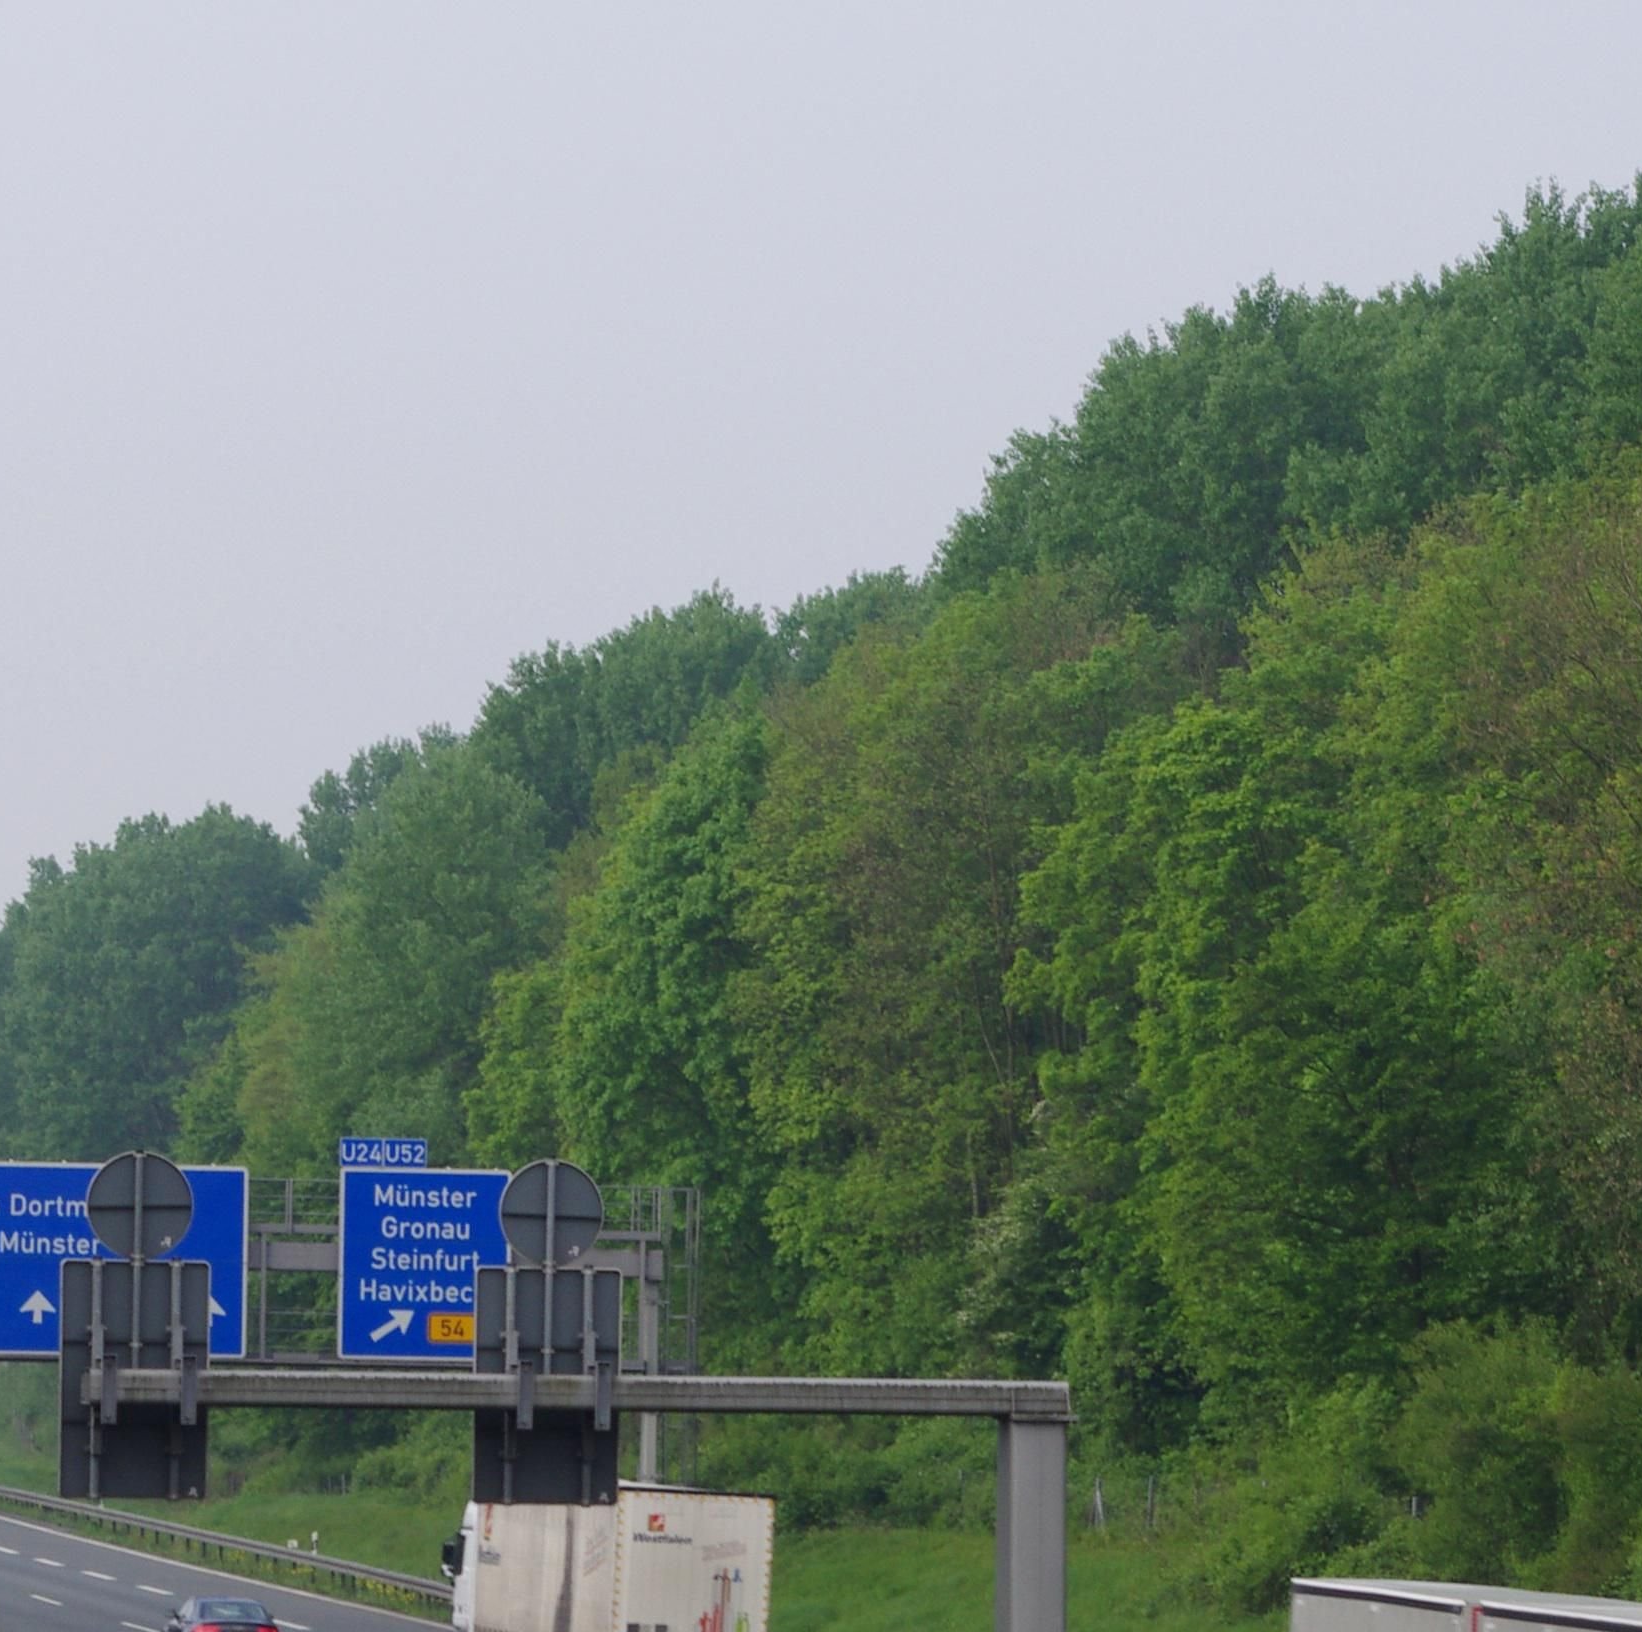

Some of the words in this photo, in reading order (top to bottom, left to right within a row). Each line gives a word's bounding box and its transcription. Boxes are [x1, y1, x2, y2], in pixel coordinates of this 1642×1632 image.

[341, 1143, 382, 1163] U24
[385, 1144, 426, 1164] U52
[10, 1193, 89, 1217] Dortm
[373, 1183, 477, 1208] Münster
[381, 1216, 471, 1240] Gronau
[0, 1230, 101, 1255] Münster
[371, 1247, 480, 1271] Steinfurt
[360, 1278, 474, 1303] Havixbec
[440, 1319, 465, 1337] 54
